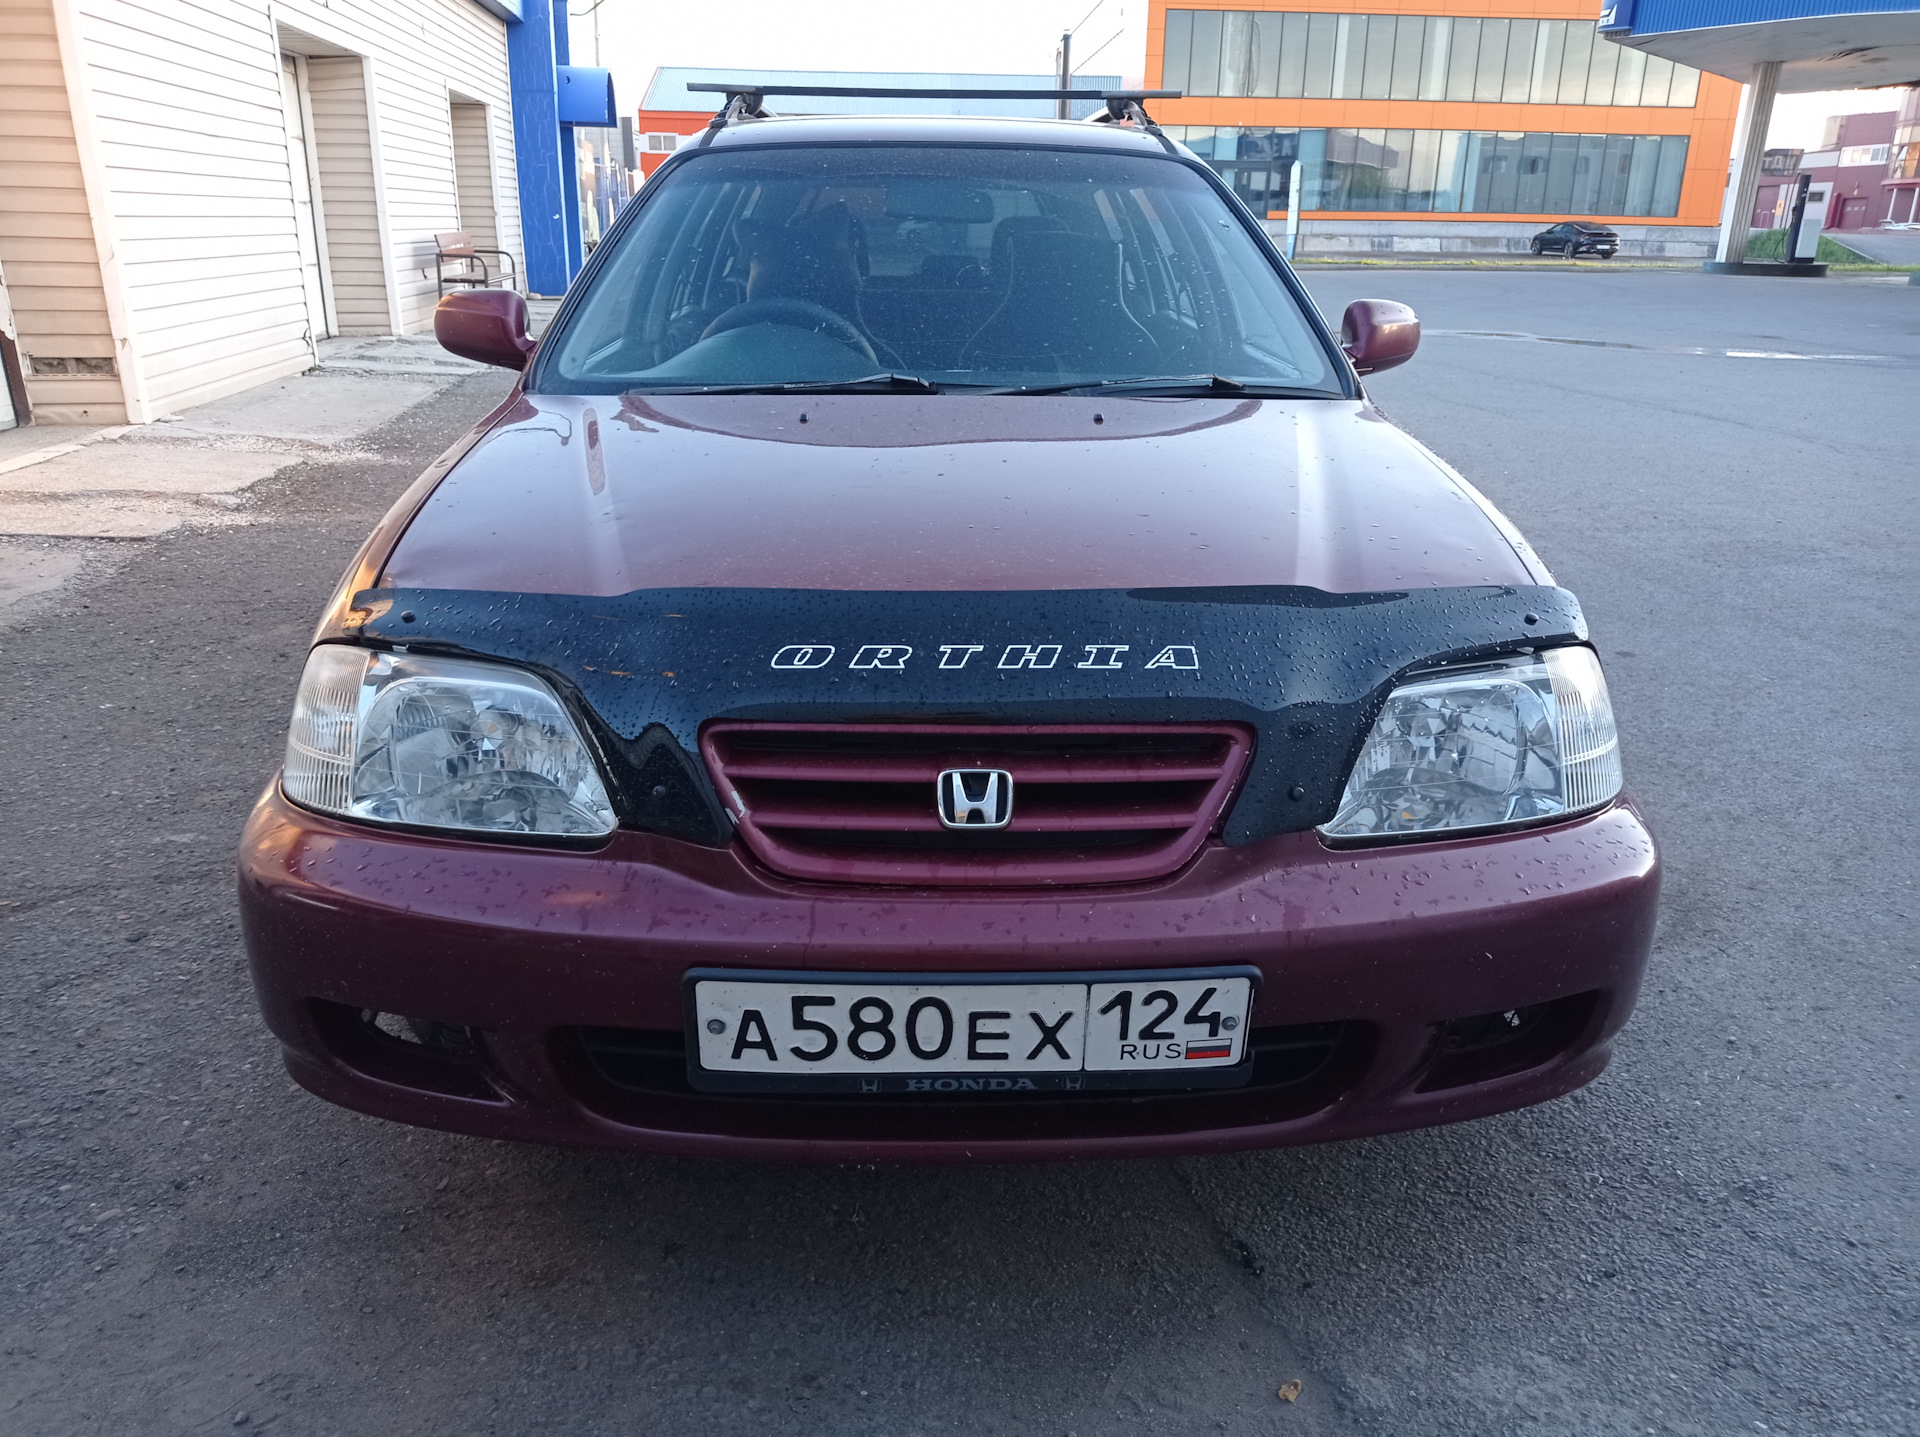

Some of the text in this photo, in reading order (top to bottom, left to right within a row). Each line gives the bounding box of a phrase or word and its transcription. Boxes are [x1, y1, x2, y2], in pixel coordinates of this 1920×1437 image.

[770, 645, 1199, 669] ORTHIA
[1098, 987, 1221, 1040] 124
[1120, 1043, 1182, 1060] RUS
[906, 1078, 1038, 1091] HONDA
